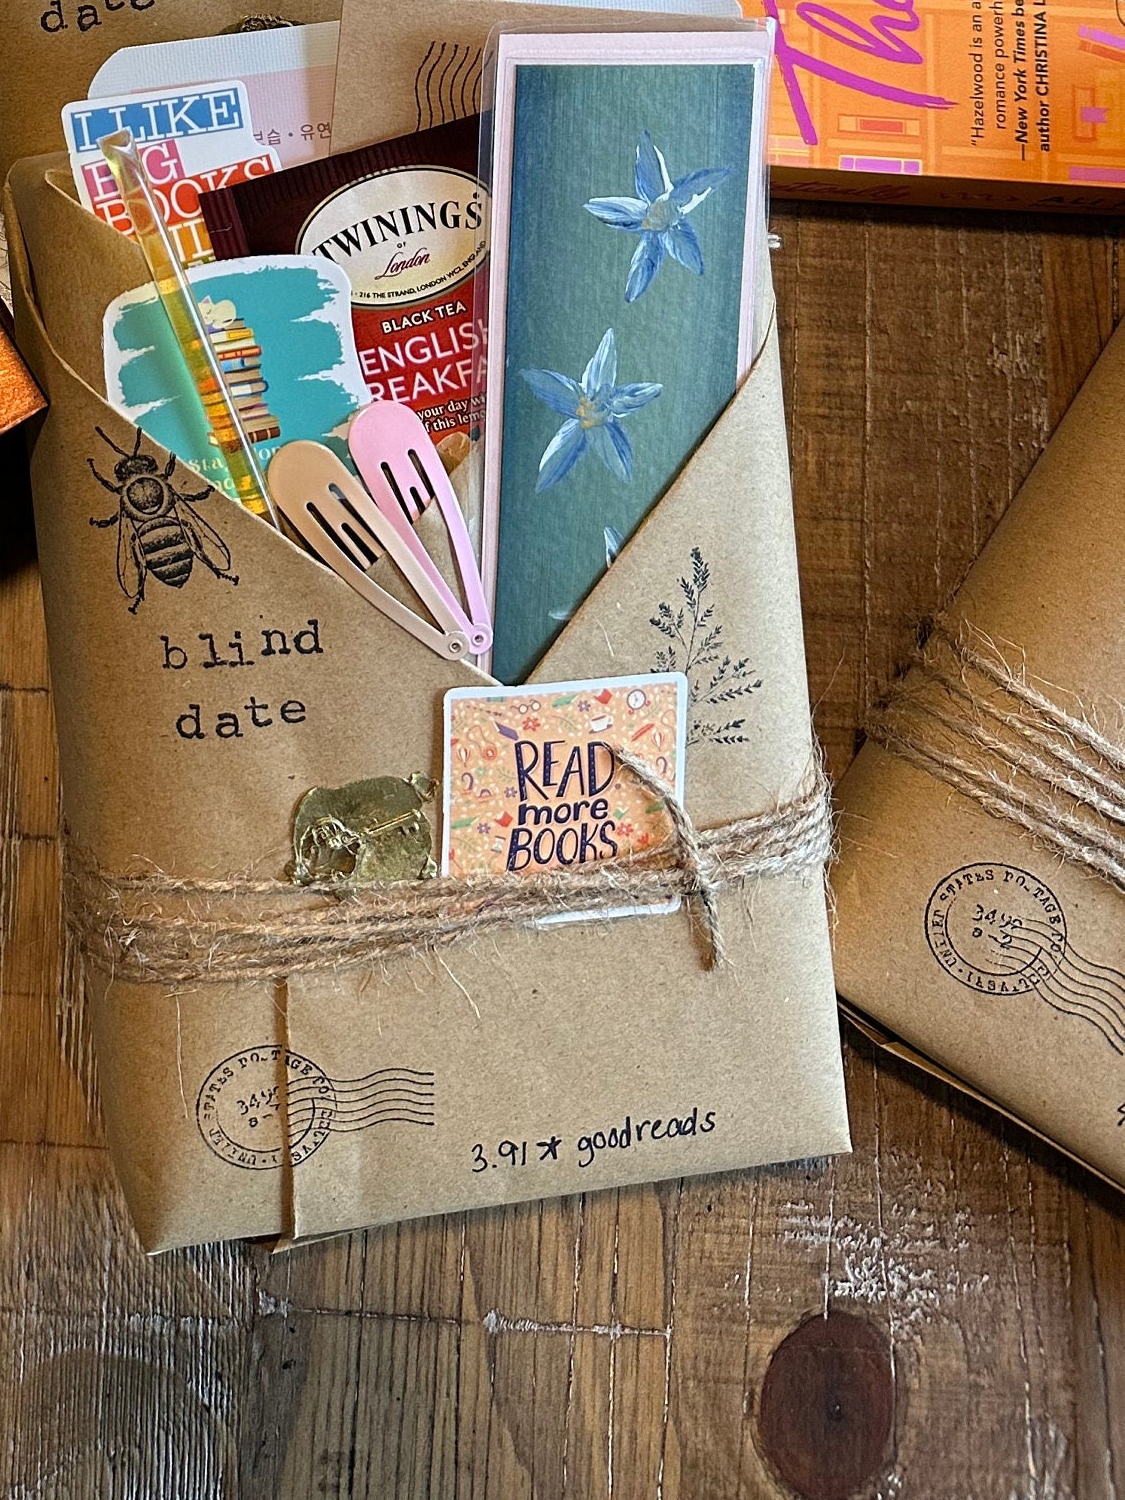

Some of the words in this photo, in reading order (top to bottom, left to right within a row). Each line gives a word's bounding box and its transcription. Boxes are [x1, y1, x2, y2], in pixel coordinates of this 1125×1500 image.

[970, 37, 984, 50] is
[973, 14, 983, 32] an
[1012, 20, 1027, 65] Times
[1034, 11, 1050, 98] CHRISTINA
[969, 52, 984, 147] “Hazelwood
[995, 62, 1007, 130] romance
[1013, 69, 1028, 103] York
[74, 111, 99, 151] I
[108, 89, 240, 143] LIKE
[1036, 100, 1051, 152] author
[312, 199, 483, 264] TWININGS
[374, 248, 431, 281] London
[359, 291, 371, 299] 216
[372, 291, 386, 300] THE
[387, 287, 416, 300] STRAND,
[416, 275, 448, 292] LONDON
[382, 310, 434, 335] BLACK
[435, 300, 468, 321] TEA
[365, 356, 488, 402] REAKFA
[417, 405, 446, 423] your
[447, 400, 470, 418] day
[432, 415, 458, 432] this
[159, 618, 324, 669] blind
[175, 696, 306, 740] date
[514, 739, 616, 802] READ
[518, 798, 609, 826] more
[506, 819, 619, 872] BOOKS
[471, 1139, 528, 1174] 3.91
[577, 1106, 717, 1169] goodreads
